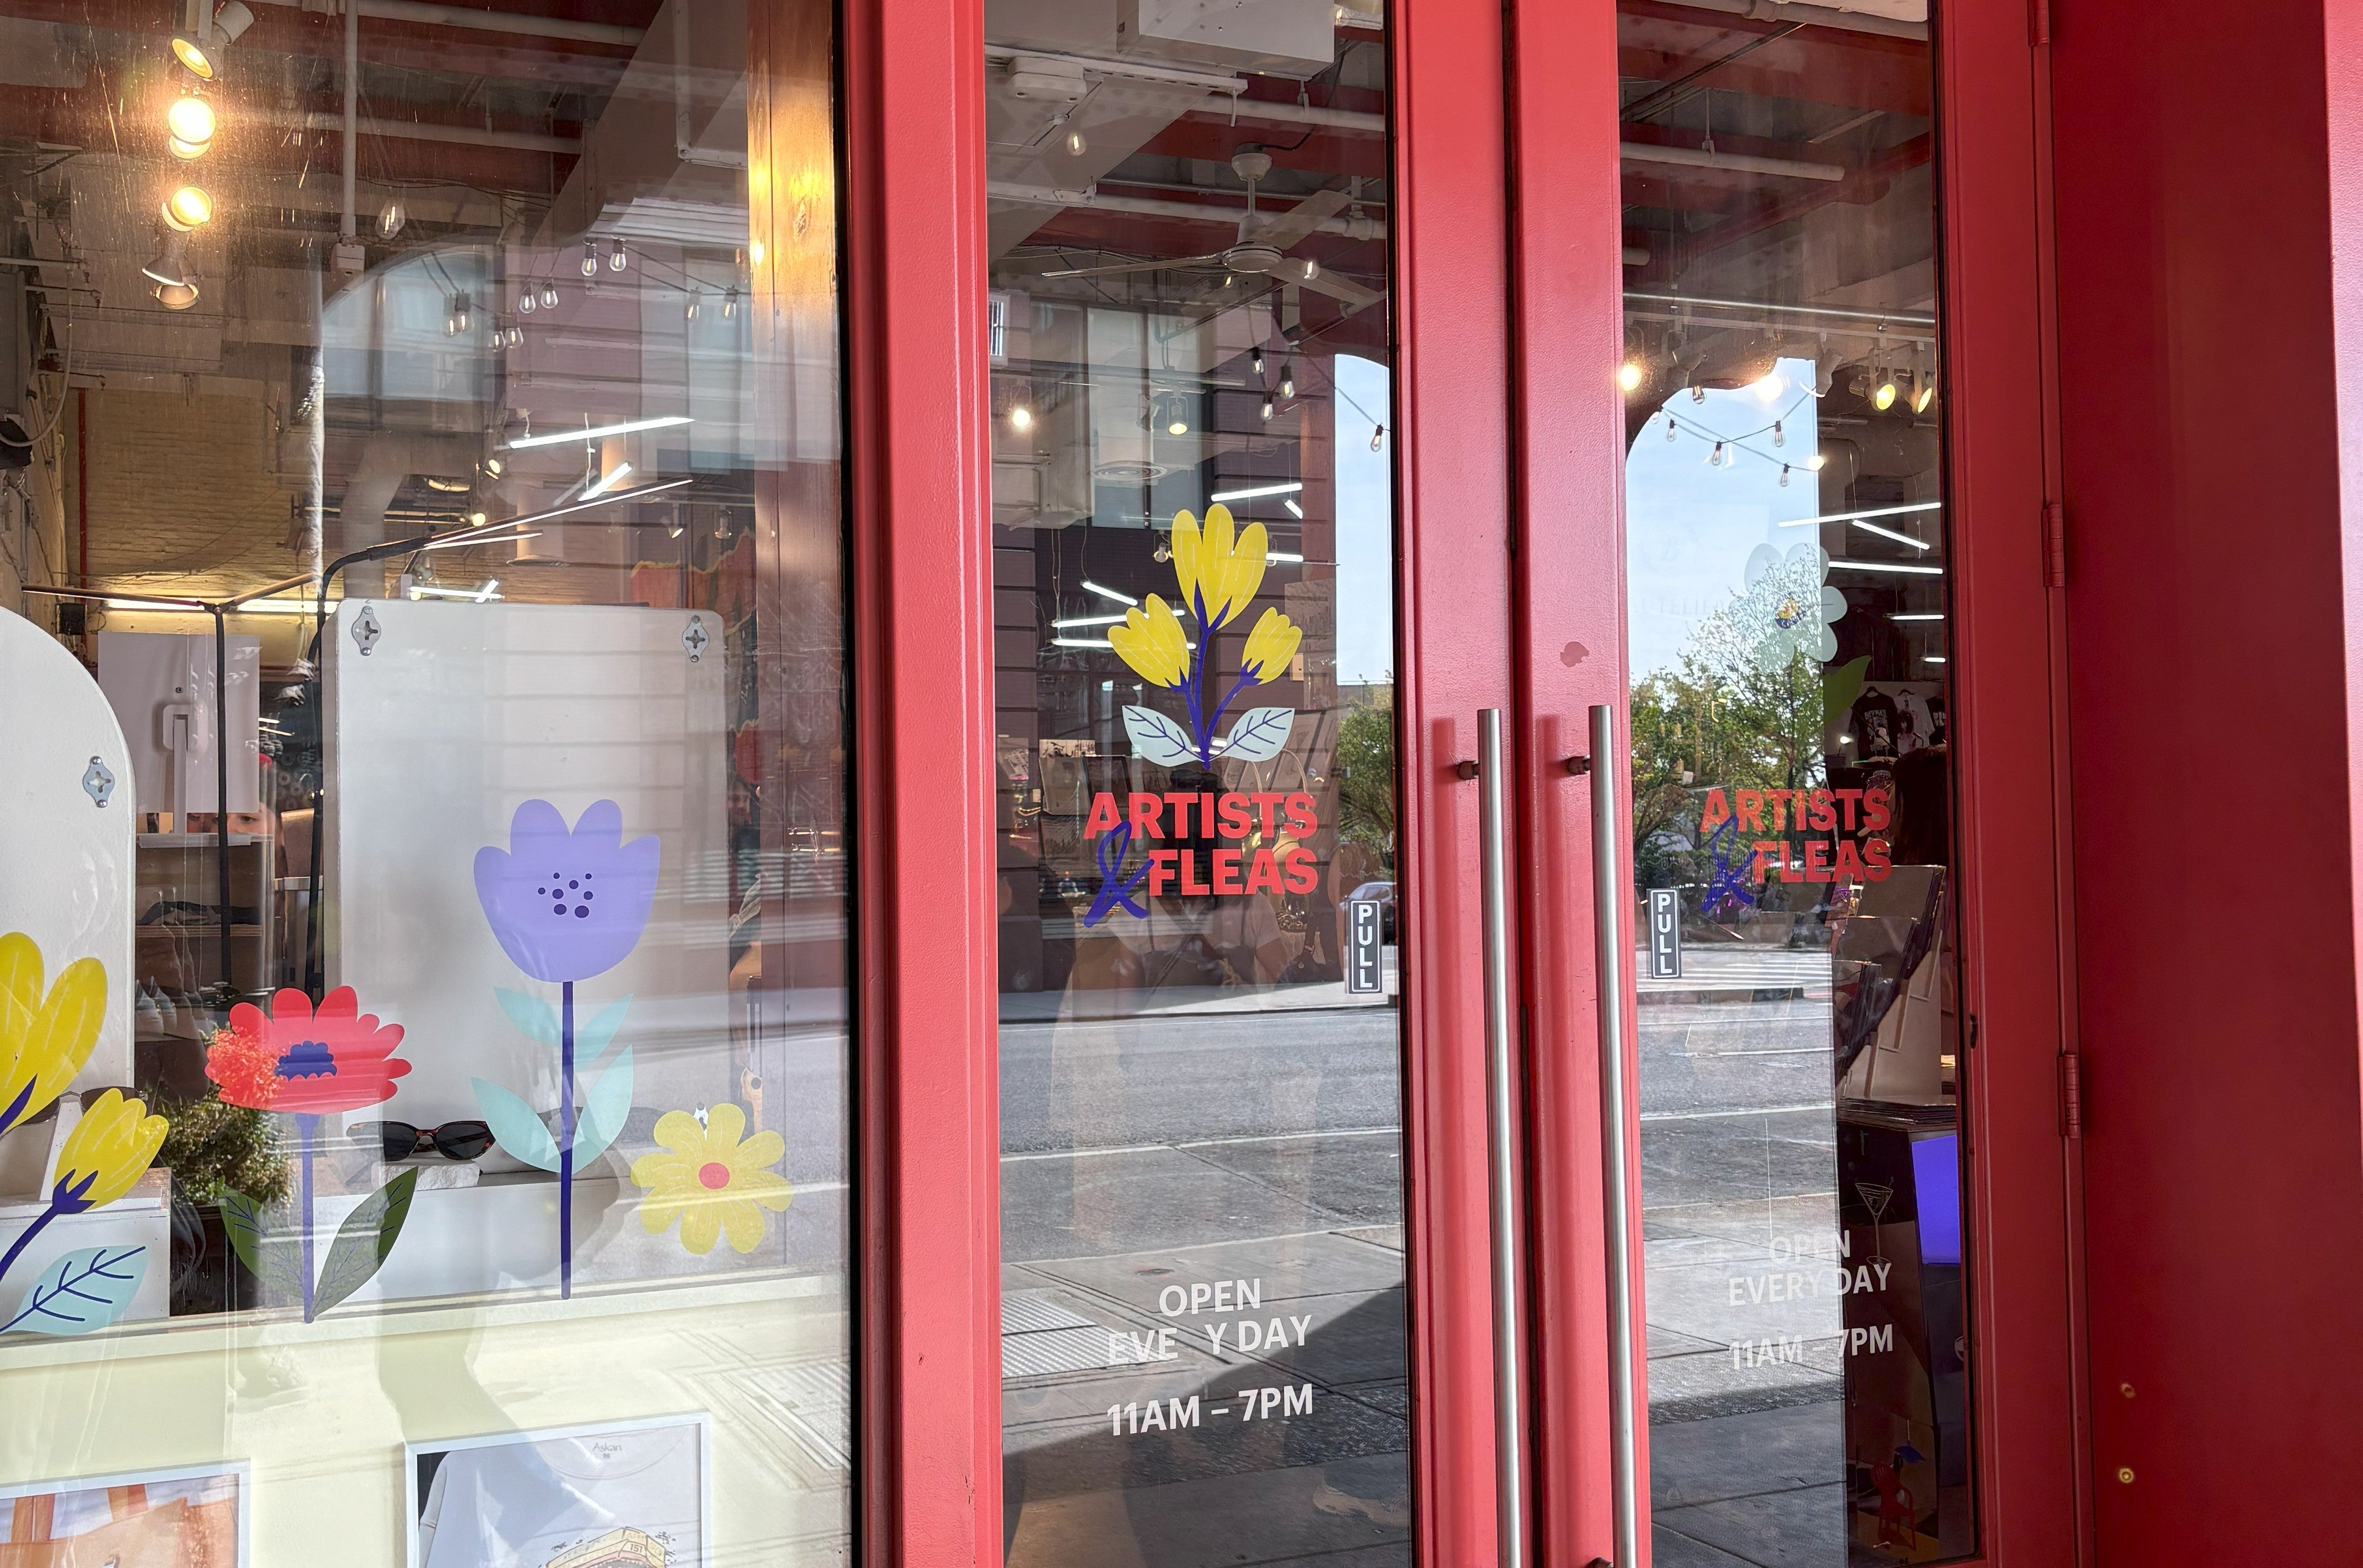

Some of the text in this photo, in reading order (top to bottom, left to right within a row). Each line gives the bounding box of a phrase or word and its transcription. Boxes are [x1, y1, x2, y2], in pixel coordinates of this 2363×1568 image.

[1083, 792, 1317, 839] ARTISTS
[1699, 789, 1891, 832] ARTISTS
[1083, 821, 1318, 928] & FLEAS
[1701, 814, 1891, 912] & FLEAS
[1357, 905, 1373, 988] PULL
[1658, 893, 1672, 974] PULL
[1769, 1230, 1851, 1265] OPEN
[1159, 1278, 1261, 1317] OPEN
[1729, 1262, 1892, 1307] EVERY DAY
[1238, 1315, 1312, 1352] DAY
[1729, 1334, 1803, 1370] 11AM
[1835, 1324, 1893, 1358] 7PM
[1107, 1395, 1200, 1436] 11AM
[1238, 1383, 1313, 1422] 7PM
